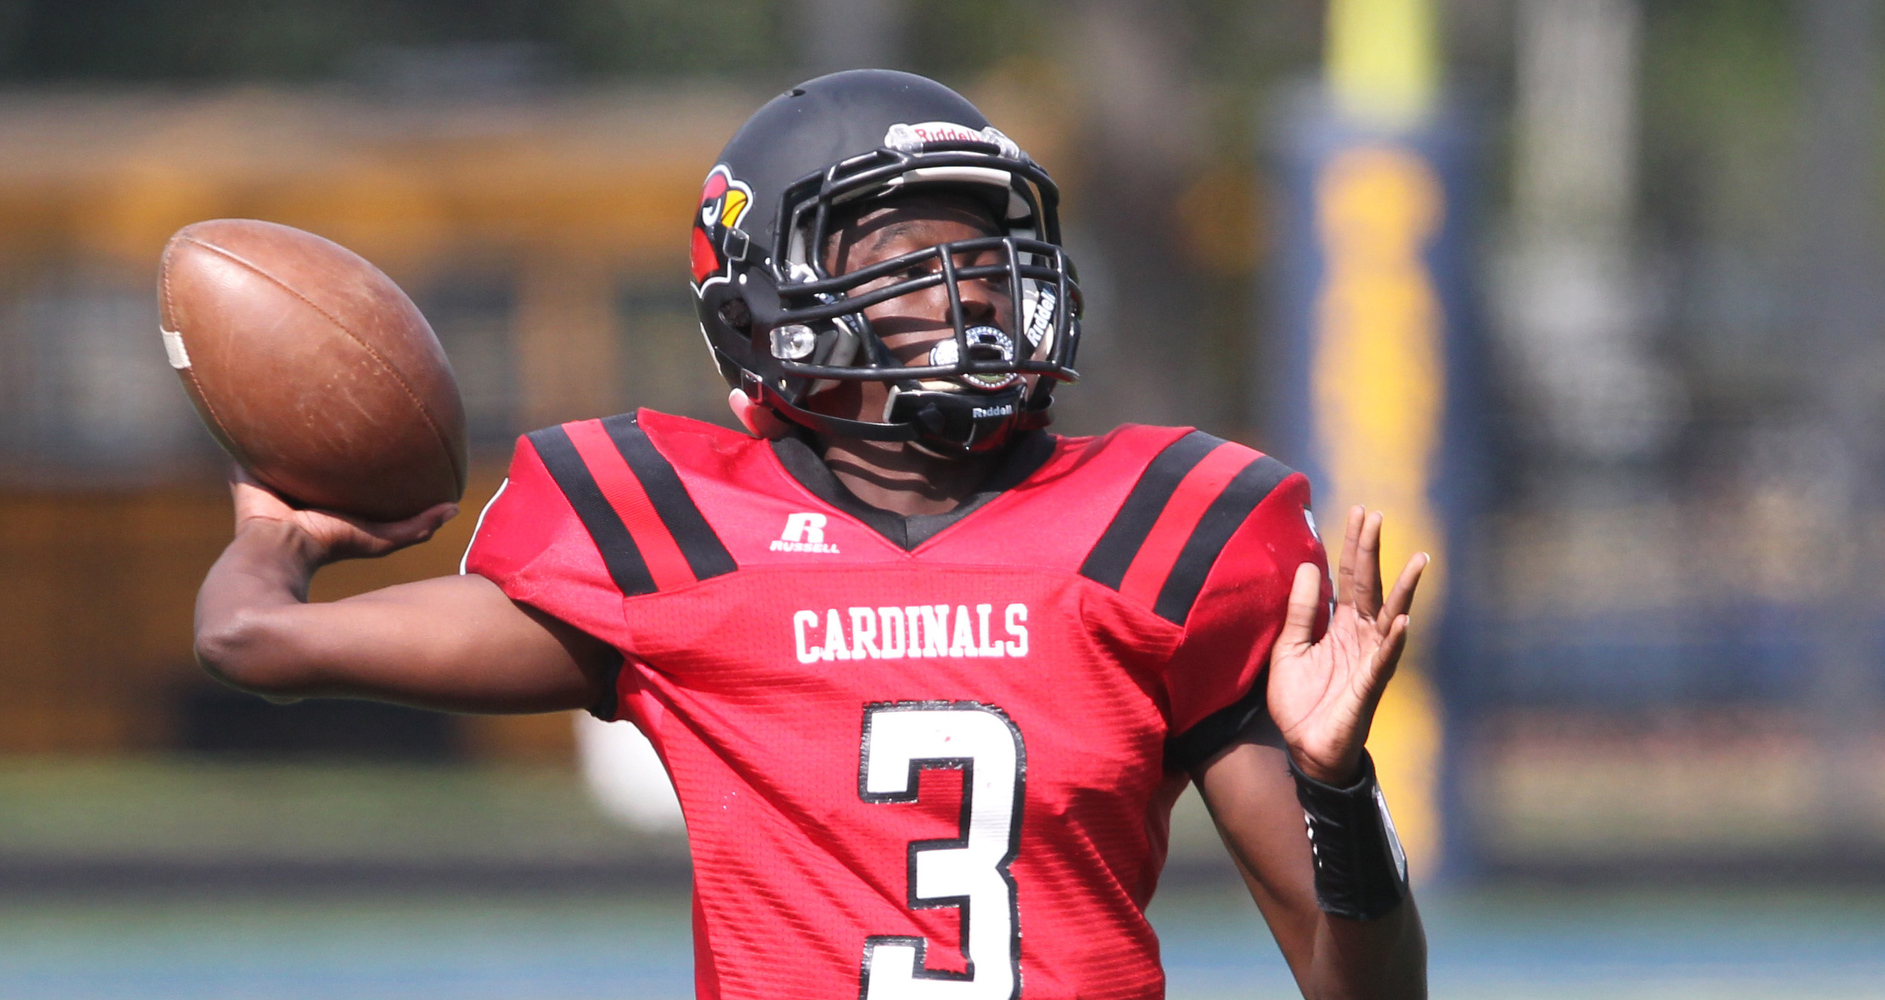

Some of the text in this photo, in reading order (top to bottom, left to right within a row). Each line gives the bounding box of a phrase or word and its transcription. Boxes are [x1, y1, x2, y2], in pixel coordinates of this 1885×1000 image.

[914, 128, 982, 142] Riddell
[1026, 288, 1056, 348] Riddell
[972, 404, 1013, 418] Riddell
[769, 540, 840, 554] RUSSELL
[793, 603, 1029, 663] CARDINALS
